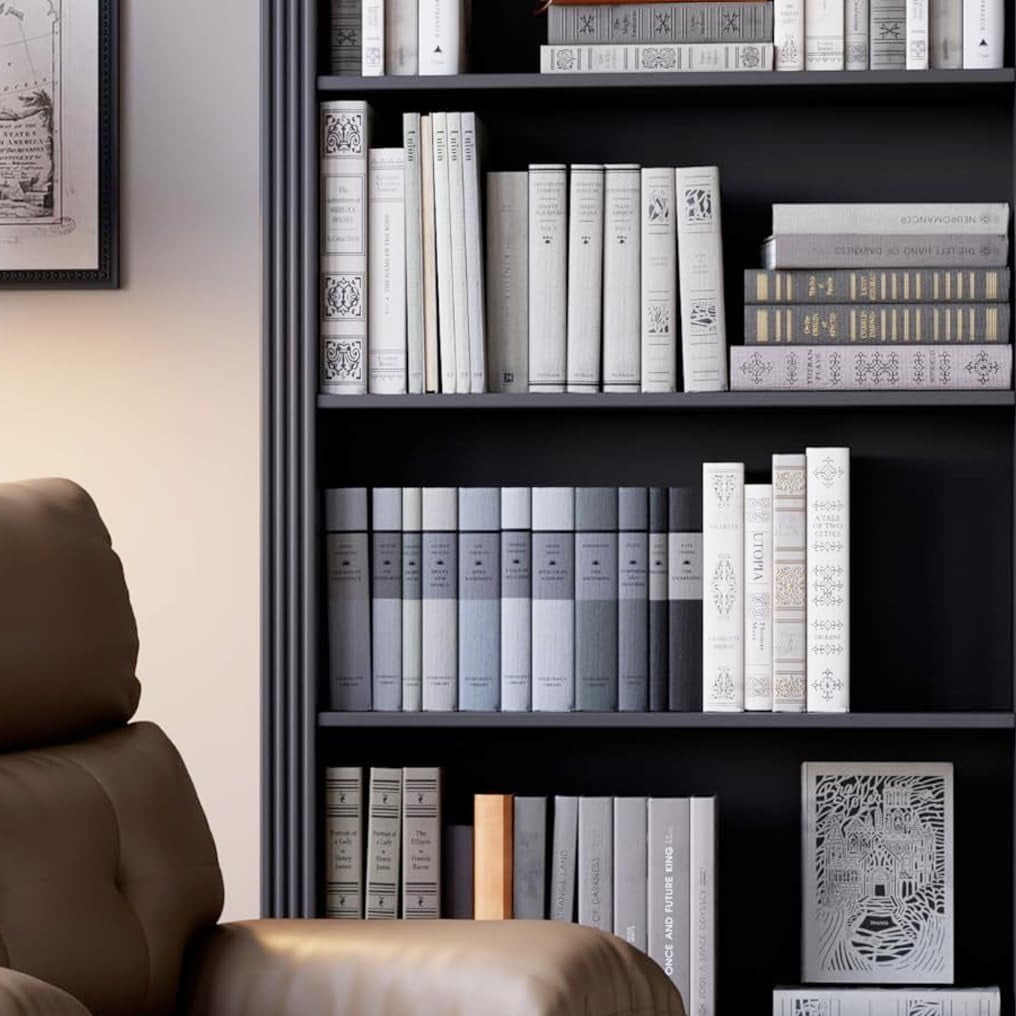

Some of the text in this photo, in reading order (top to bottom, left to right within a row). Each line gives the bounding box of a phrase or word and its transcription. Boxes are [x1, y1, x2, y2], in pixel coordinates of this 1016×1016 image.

[899, 215, 976, 225] NEUROMANCER
[833, 247, 977, 257] THE LEFT HAND OF DARKNESS
[823, 514, 841, 523] TALE
[825, 522, 844, 530] TWO
[752, 532, 765, 582] UTOPIA
[664, 846, 674, 873] KING
[555, 849, 569, 921] TRANGE LAND
[590, 856, 600, 904] DARKNESS
[664, 875, 674, 913] FUTURE
[697, 889, 707, 930] ODYSSEY
[664, 916, 674, 940] AND
[664, 944, 674, 976] ONCE
